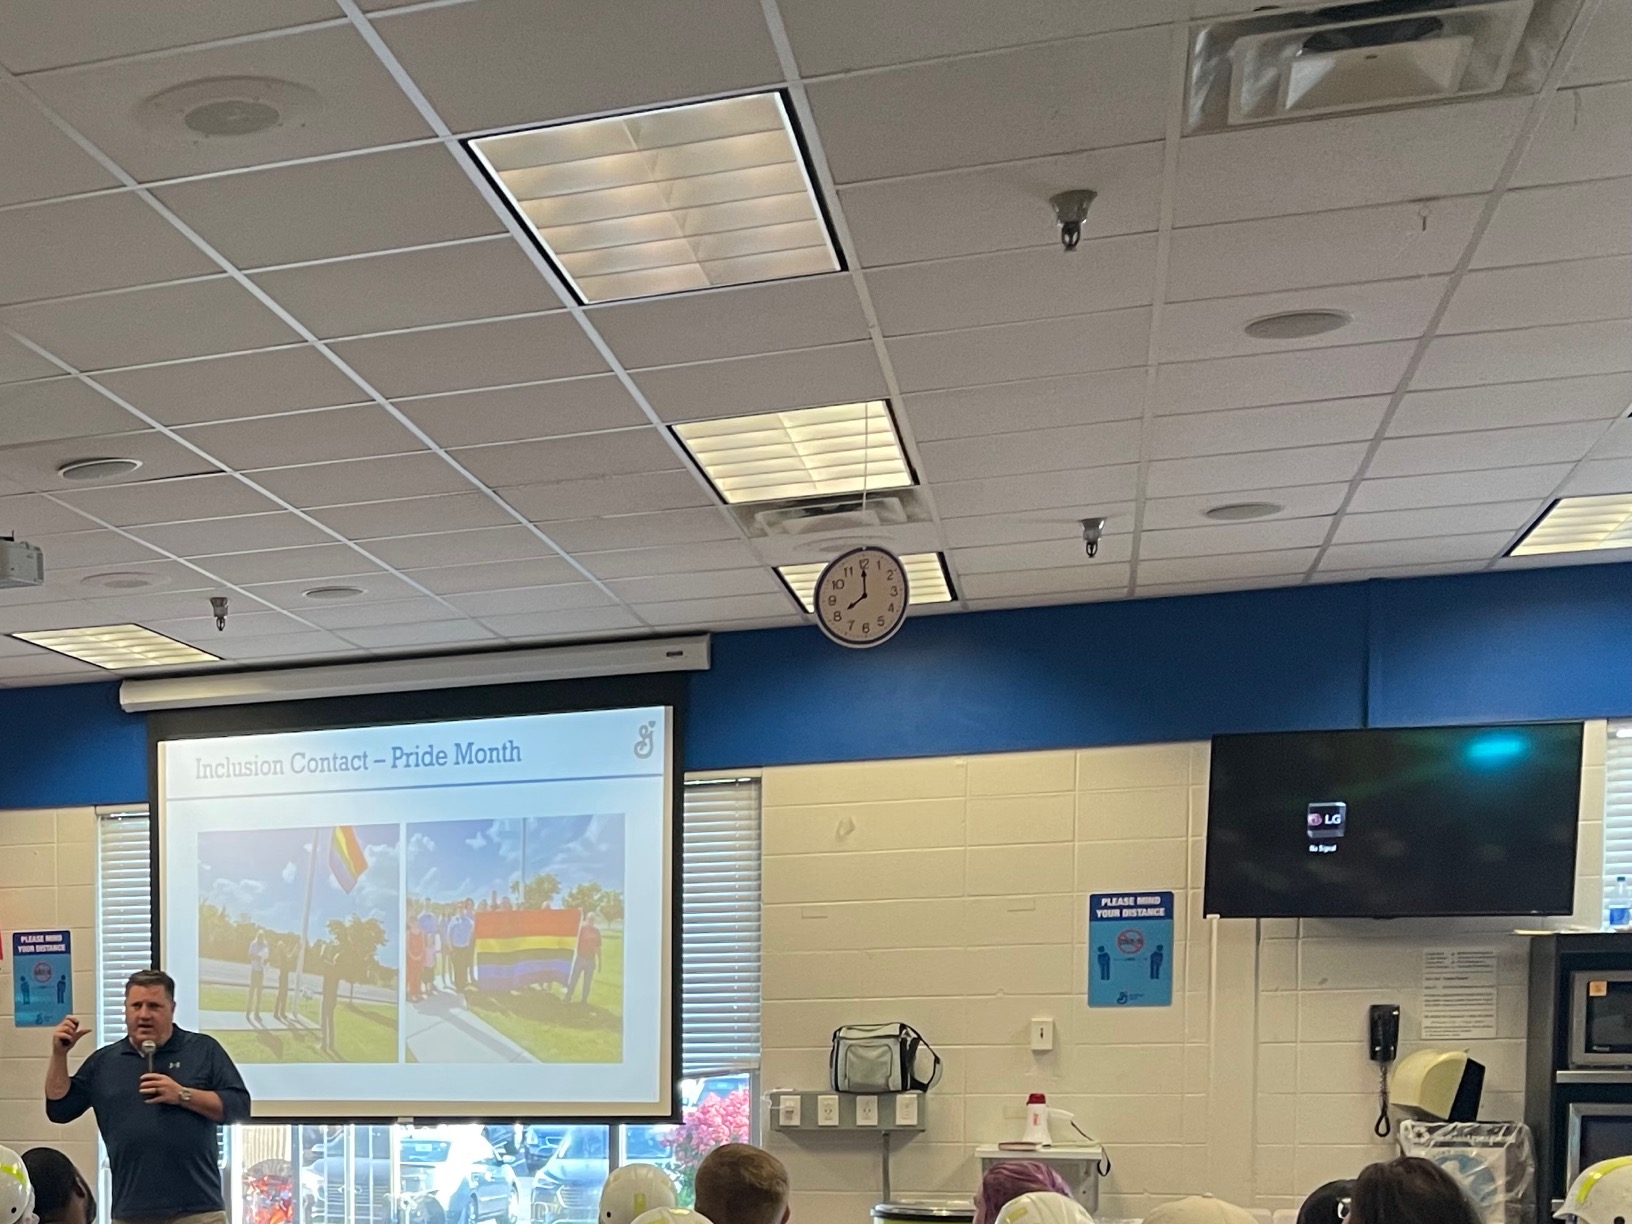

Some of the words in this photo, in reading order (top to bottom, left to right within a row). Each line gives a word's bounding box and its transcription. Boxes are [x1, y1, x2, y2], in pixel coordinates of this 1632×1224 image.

[859, 559, 869, 569] 12
[876, 560, 881, 570] 1
[844, 566, 853, 578] 11
[887, 570, 894, 580] 2
[832, 579, 845, 590] 10
[890, 586, 899, 597] 3
[828, 595, 837, 606] 9
[888, 603, 894, 613] 4
[833, 611, 842, 622] 8
[877, 616, 885, 627] 5
[848, 620, 855, 631] 7
[862, 623, 870, 633] 6
[195, 754, 285, 780] Inclusion
[290, 751, 369, 774] Contact
[391, 745, 448, 769] Pride
[453, 740, 522, 766] Month
[1325, 813, 1342, 825] LG
[1101, 897, 1135, 906] PLEASE
[1136, 896, 1161, 905] MIND
[1096, 909, 1120, 918] YOUR
[1122, 908, 1165, 917] DISTANCE
[20, 935, 44, 943] PLEASE
